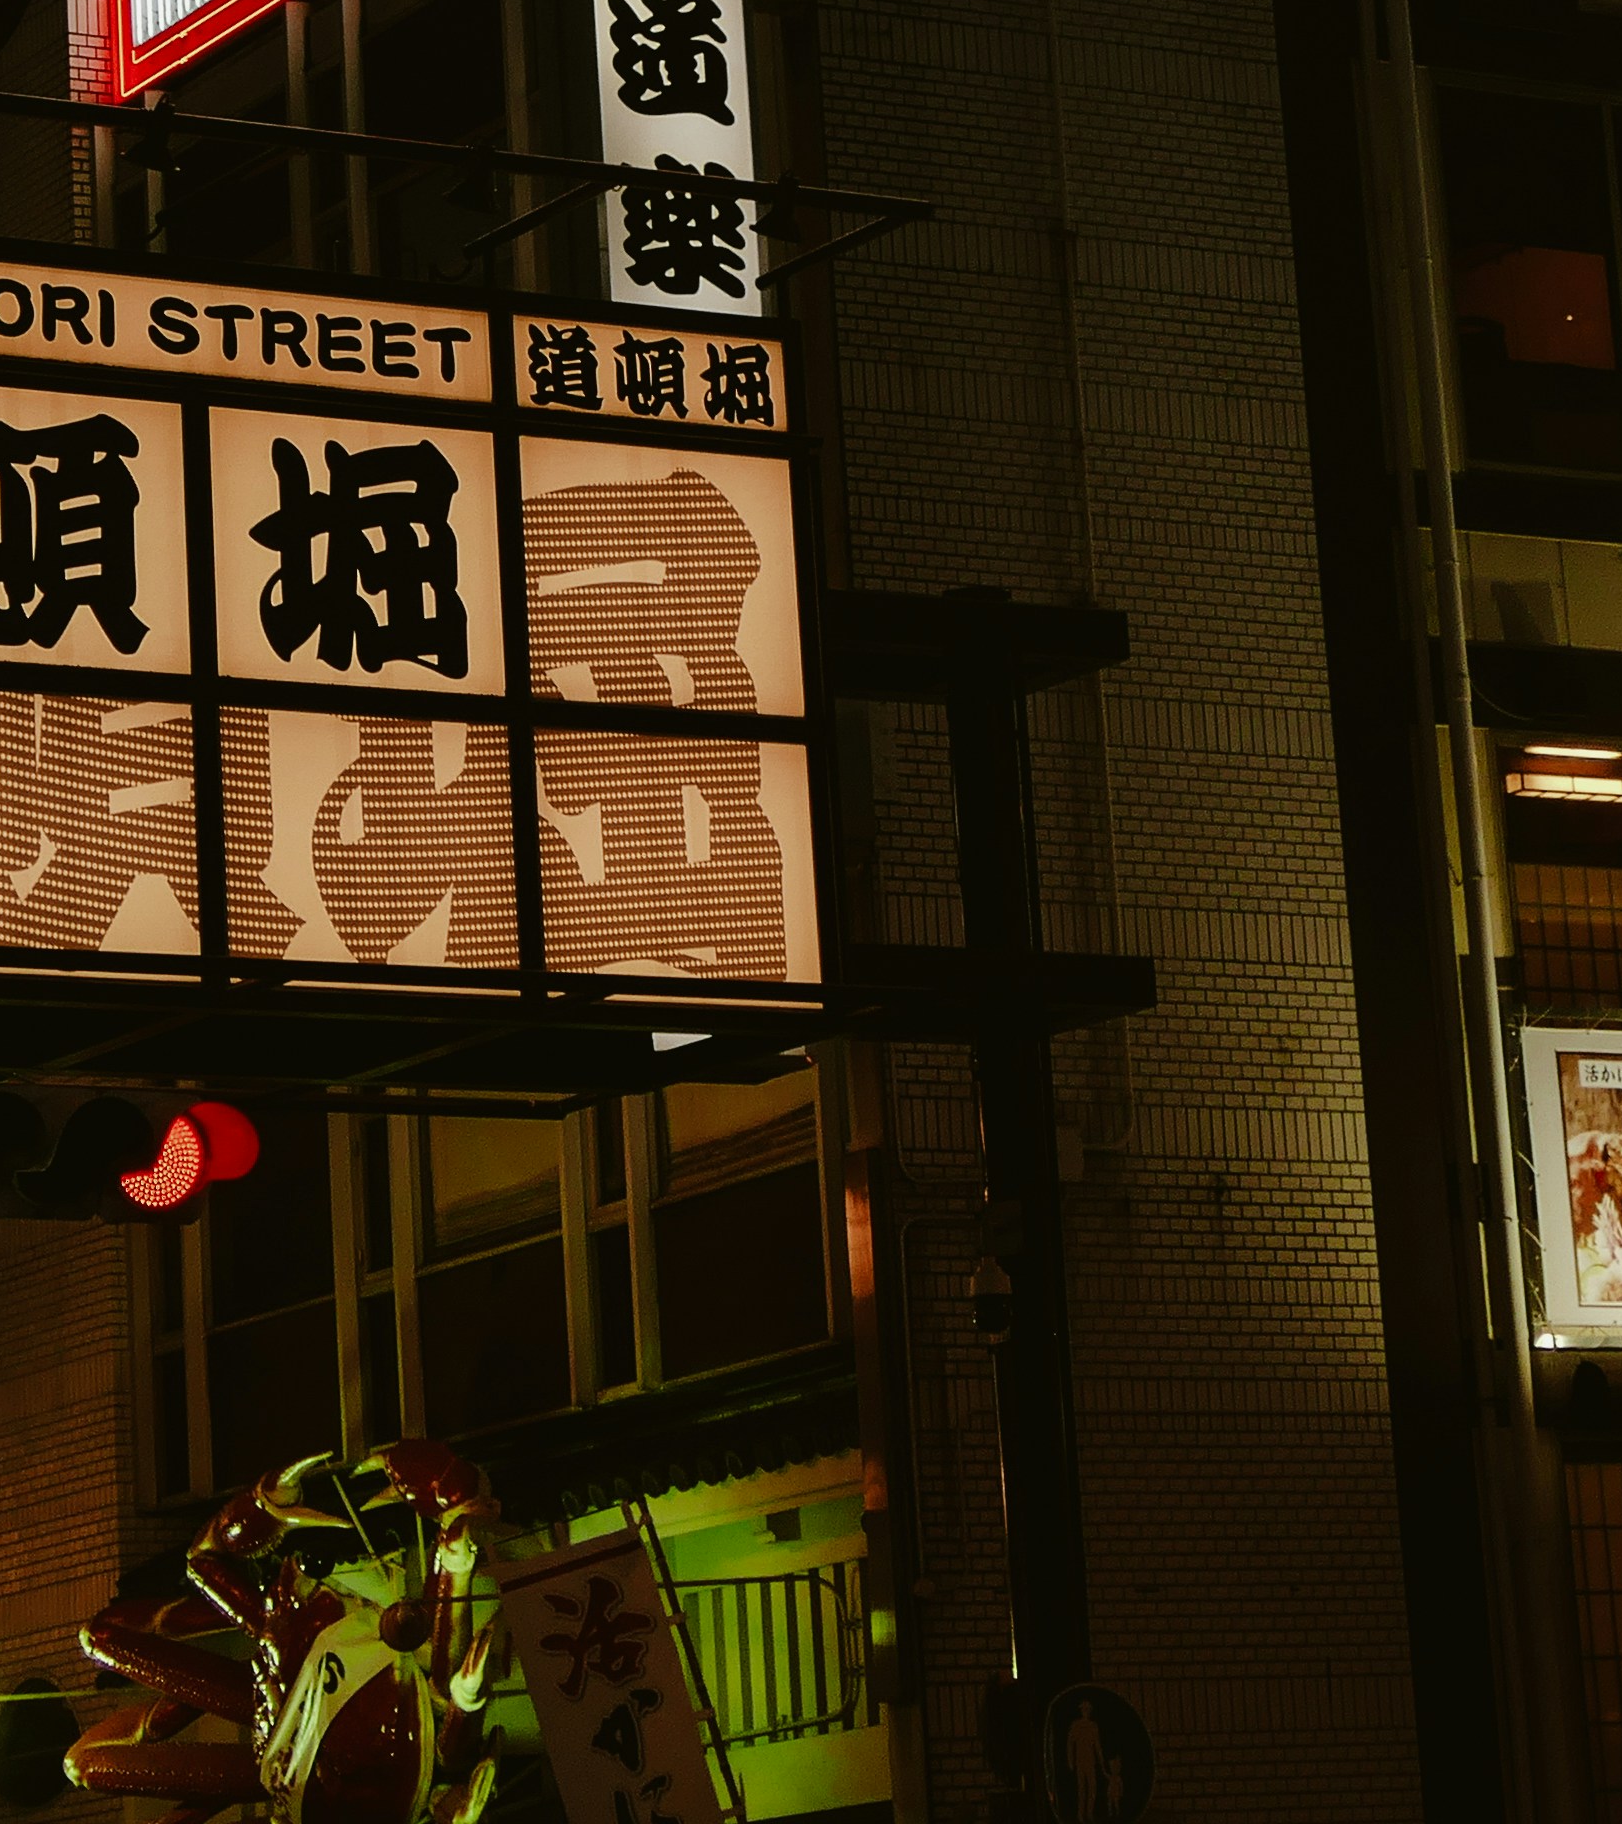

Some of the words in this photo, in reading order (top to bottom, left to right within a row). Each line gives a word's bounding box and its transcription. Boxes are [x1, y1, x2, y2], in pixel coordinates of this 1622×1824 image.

[148, 296, 472, 383] STREET
[527, 322, 775, 428] 道頓堀
